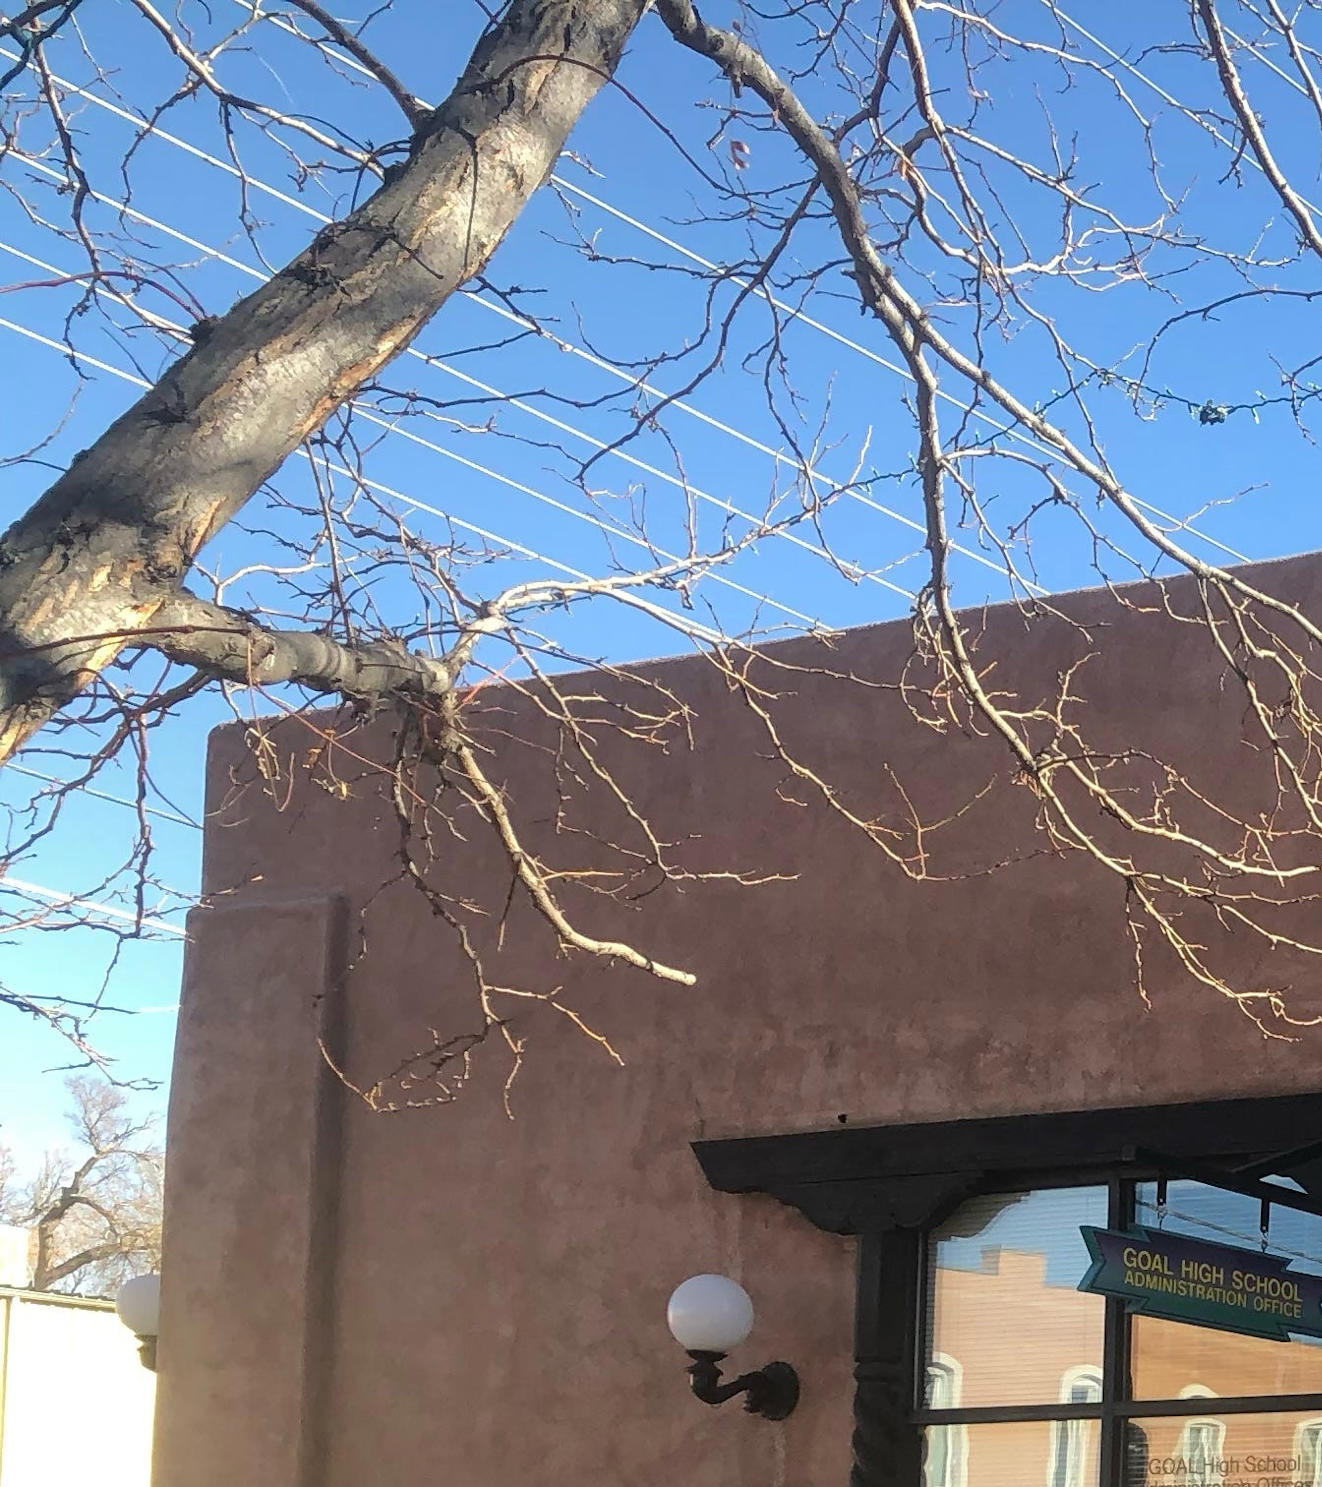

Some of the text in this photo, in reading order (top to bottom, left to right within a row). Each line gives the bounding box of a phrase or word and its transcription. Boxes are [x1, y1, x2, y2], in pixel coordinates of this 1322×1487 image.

[1123, 1247, 1303, 1302] GOAL HIGH SCHOOL
[1123, 1270, 1302, 1318] ADMINISTRATION OFFICE
[1149, 1453, 1302, 1478] GOAL High School
